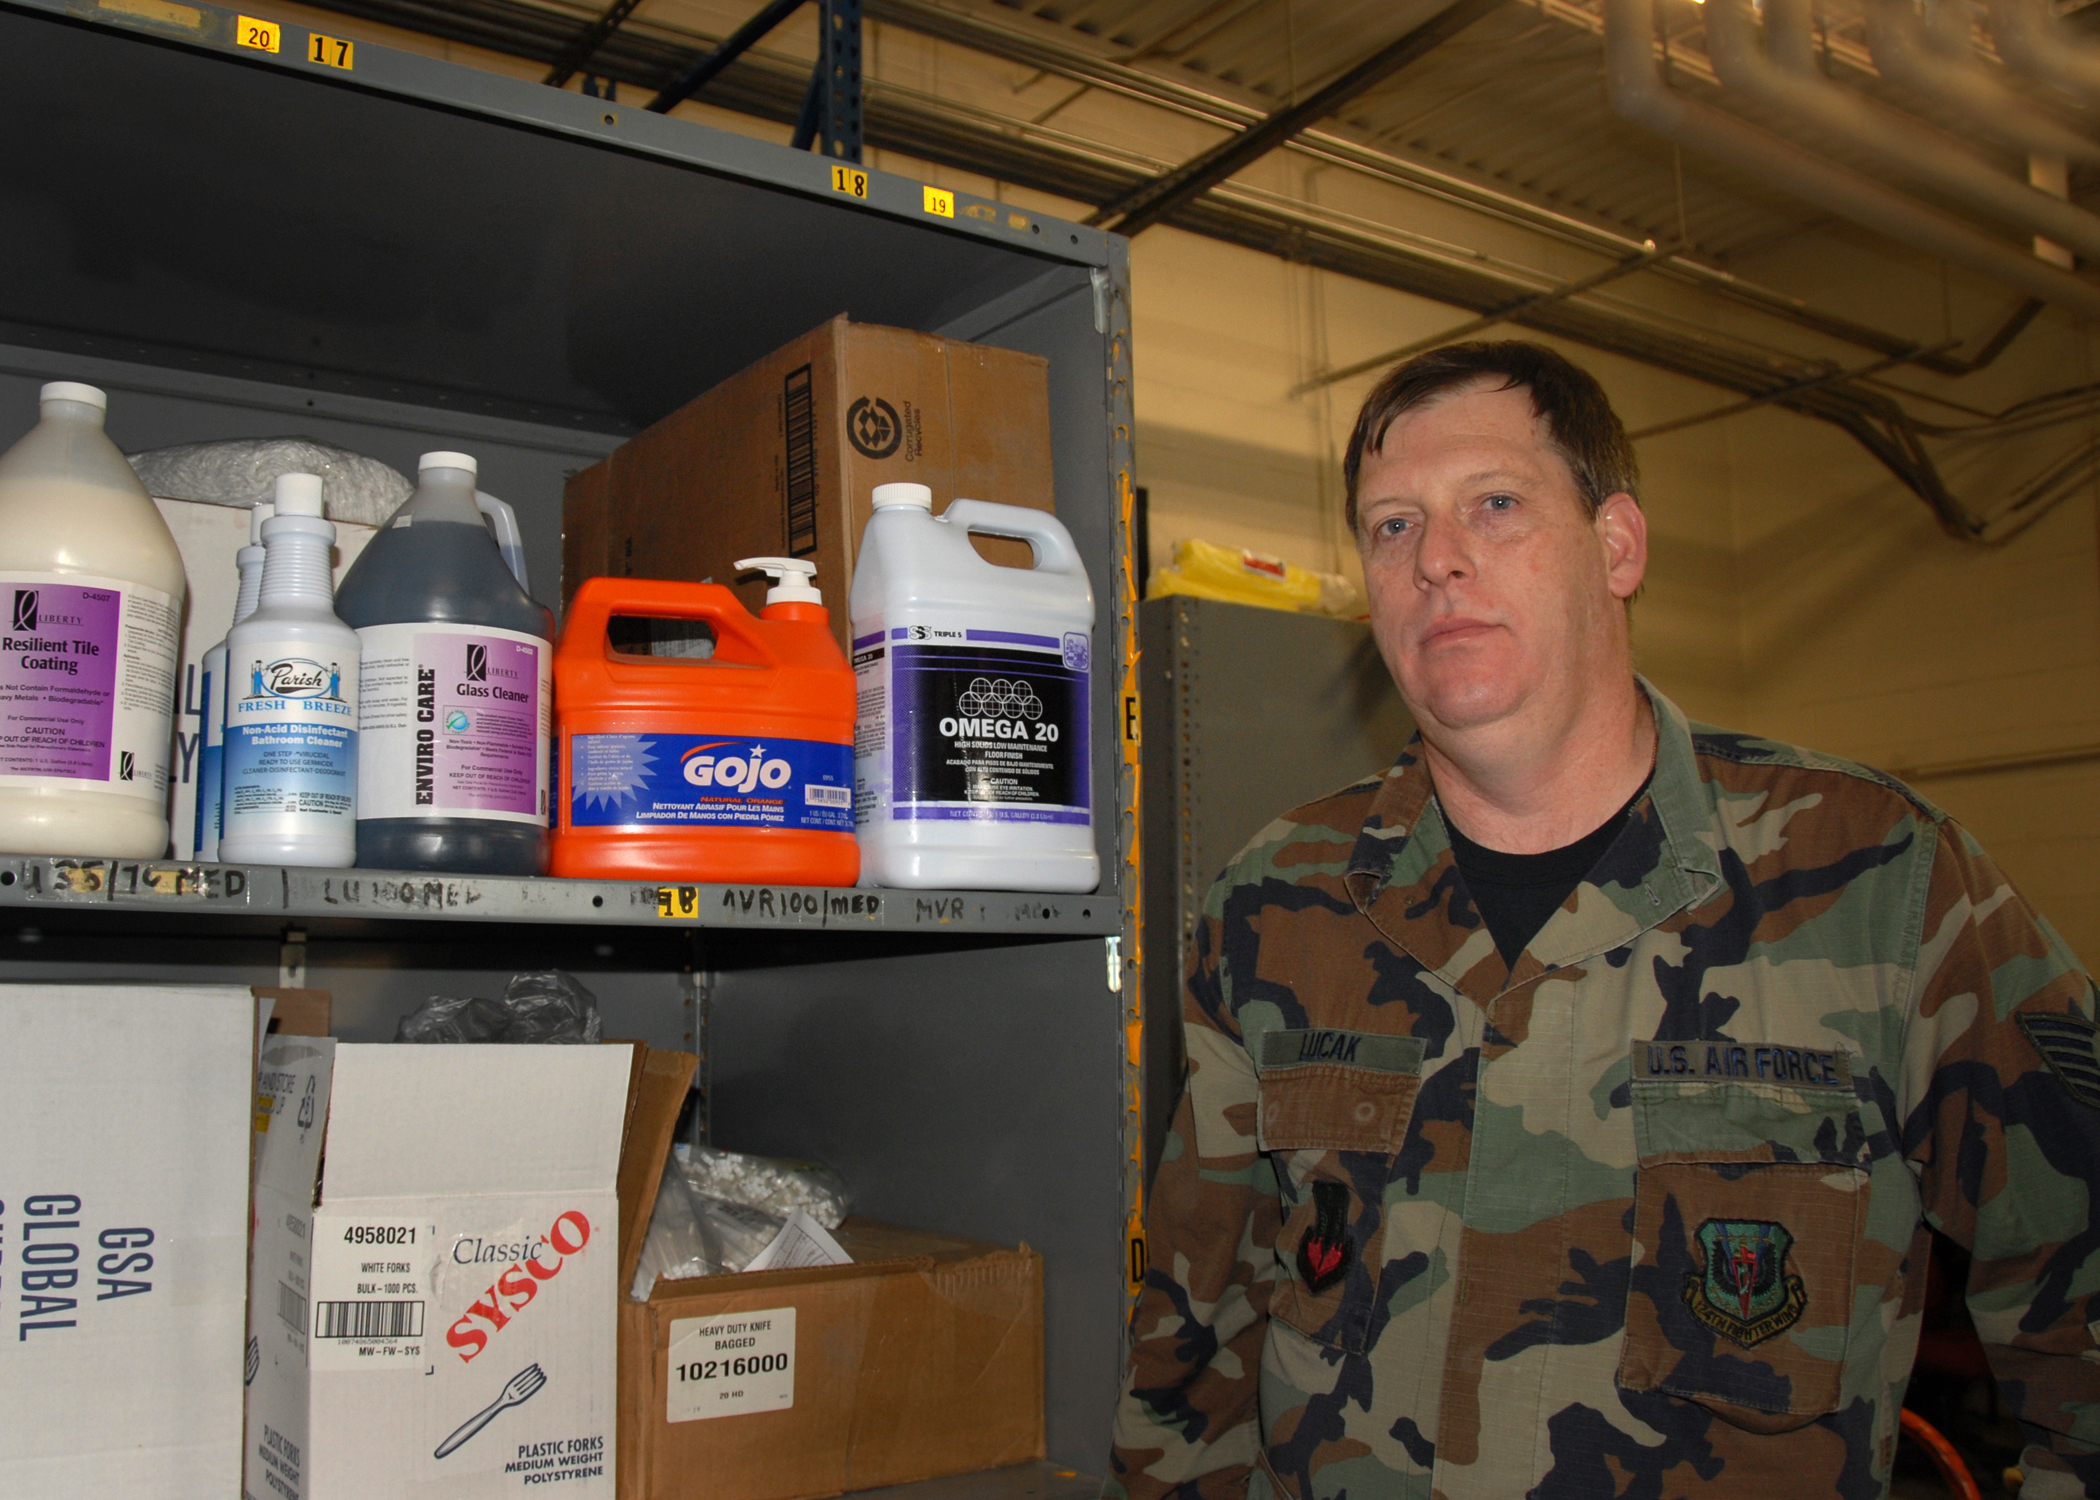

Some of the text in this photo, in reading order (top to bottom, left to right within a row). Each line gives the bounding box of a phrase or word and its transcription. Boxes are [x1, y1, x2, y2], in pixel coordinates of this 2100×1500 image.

[248, 27, 270, 47] 20
[313, 36, 349, 67] 17
[837, 168, 865, 197] 18
[932, 197, 946, 213] 19
[902, 401, 914, 462] Corrugated
[913, 408, 922, 457] Recycles
[38, 614, 84, 625] LIBERTY
[934, 630, 957, 638] TRIPLE
[2, 637, 100, 656] Resilient Tile
[21, 655, 79, 676] Coating
[487, 667, 518, 678] LIBERTY
[270, 662, 323, 690] Parish
[20, 684, 48, 692] Contain
[50, 685, 101, 697] Formaldehyde
[456, 683, 529, 703] Glass Cleaner
[237, 700, 286, 713] FRESH
[303, 700, 352, 716] BREEZE
[25, 726, 66, 735] CAUTION
[242, 724, 348, 738] Non-Acid Disinfectant
[939, 717, 1059, 742] OMEGA 20
[31, 736, 57, 744] REACH
[70, 739, 105, 748] CHILDREN
[251, 735, 343, 748] Bathroom Cleaner
[954, 740, 1048, 753] HIGH SOLIDS LOW MAINTENANCE
[984, 750, 1023, 760] FLOOR FINISH
[416, 729, 434, 805] ENVIRO
[684, 755, 792, 794] GOJO
[299, 799, 324, 807] CAUTION
[652, 802, 695, 811] NETTOYANT
[695, 802, 726, 811] ABRASIF
[726, 803, 747, 812] POUR
[762, 805, 785, 813] MAINS
[700, 796, 784, 805] NATURAL ORANGE
[636, 811, 677, 820] LIMPIADOR
[677, 812, 688, 820] DE
[689, 812, 717, 820] MANOS
[735, 812, 760, 821] PIEDRA
[1298, 1031, 1362, 1063] LUCAK
[1647, 1045, 1838, 1086] U.S. AIR FORCE
[343, 1226, 416, 1244] 4958021
[453, 1235, 543, 1265] Classic
[19, 1194, 82, 1342] GLOBAL
[97, 1227, 155, 1301] GSA
[361, 1262, 411, 1273] WHITE FORKS
[1131, 1238, 1145, 1283] D
[446, 1210, 591, 1364] SYSCO
[699, 1320, 772, 1337] HEAVY DUTY KNIFE
[714, 1337, 756, 1351] BAGGED
[676, 1352, 788, 1382] 10216000
[719, 1390, 744, 1400] 20 HD
[518, 1435, 604, 1459] PLASTIC FORKS
[504, 1451, 604, 1473] MEDIUM WEIGHT
[524, 1465, 603, 1485] POLYSTYRENE
